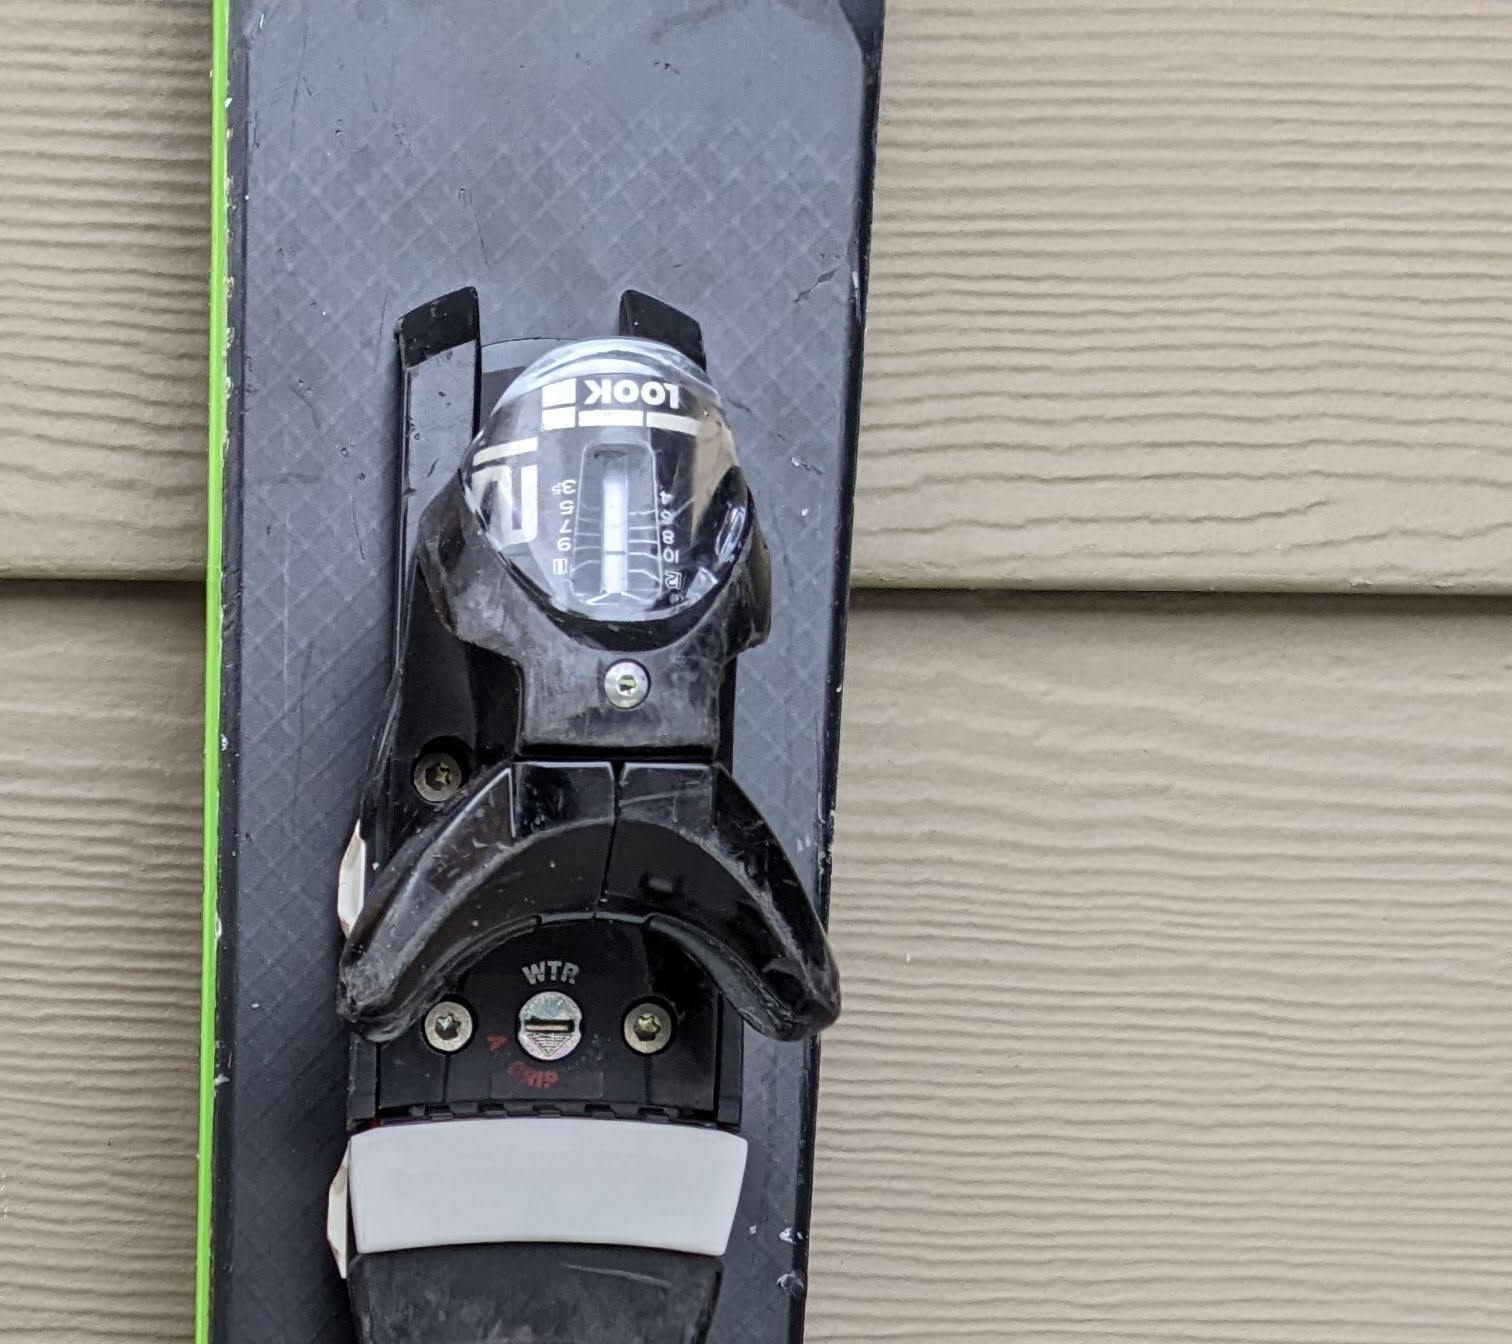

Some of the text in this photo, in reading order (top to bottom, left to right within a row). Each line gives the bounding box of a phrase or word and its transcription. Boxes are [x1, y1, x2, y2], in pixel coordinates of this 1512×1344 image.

[584, 379, 680, 410] LOOK
[662, 530, 675, 544] 8
[663, 551, 679, 563] 10
[521, 960, 580, 985] WTR
